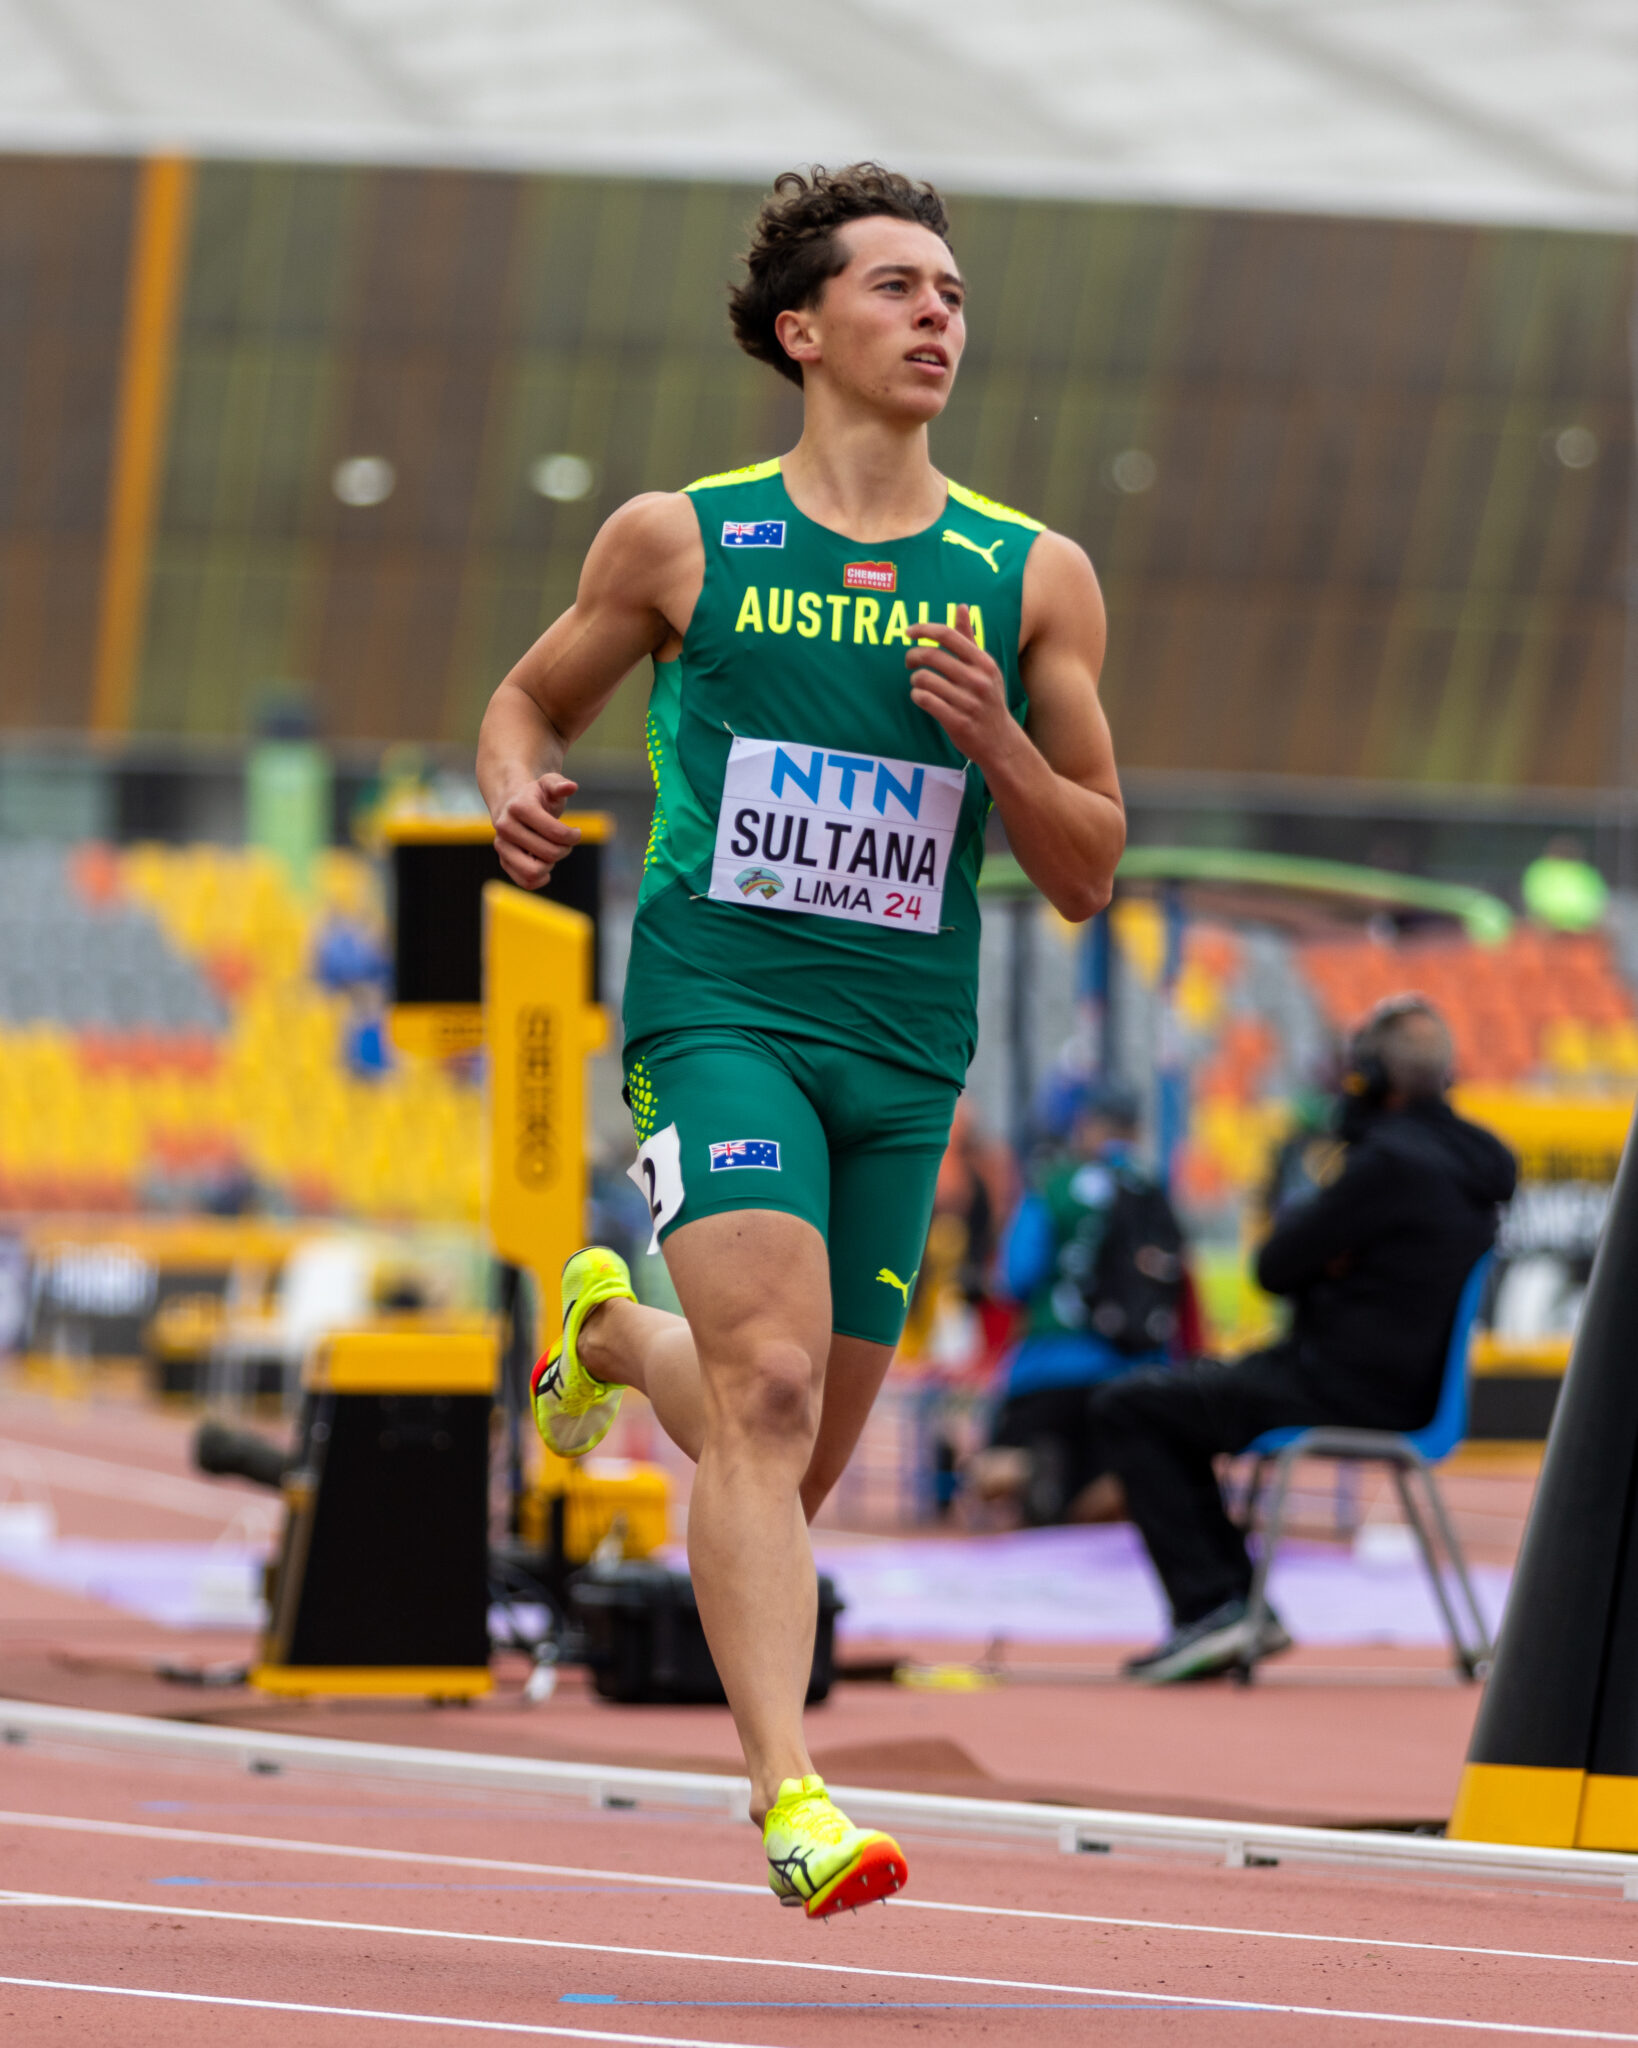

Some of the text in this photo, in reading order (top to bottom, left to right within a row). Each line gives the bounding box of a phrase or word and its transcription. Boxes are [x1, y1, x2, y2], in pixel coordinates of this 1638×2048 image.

[847, 568, 893, 582] CHEMIST
[770, 746, 925, 821] NTN
[730, 808, 936, 887] SULTANA
[793, 877, 922, 921] LIMA 24
